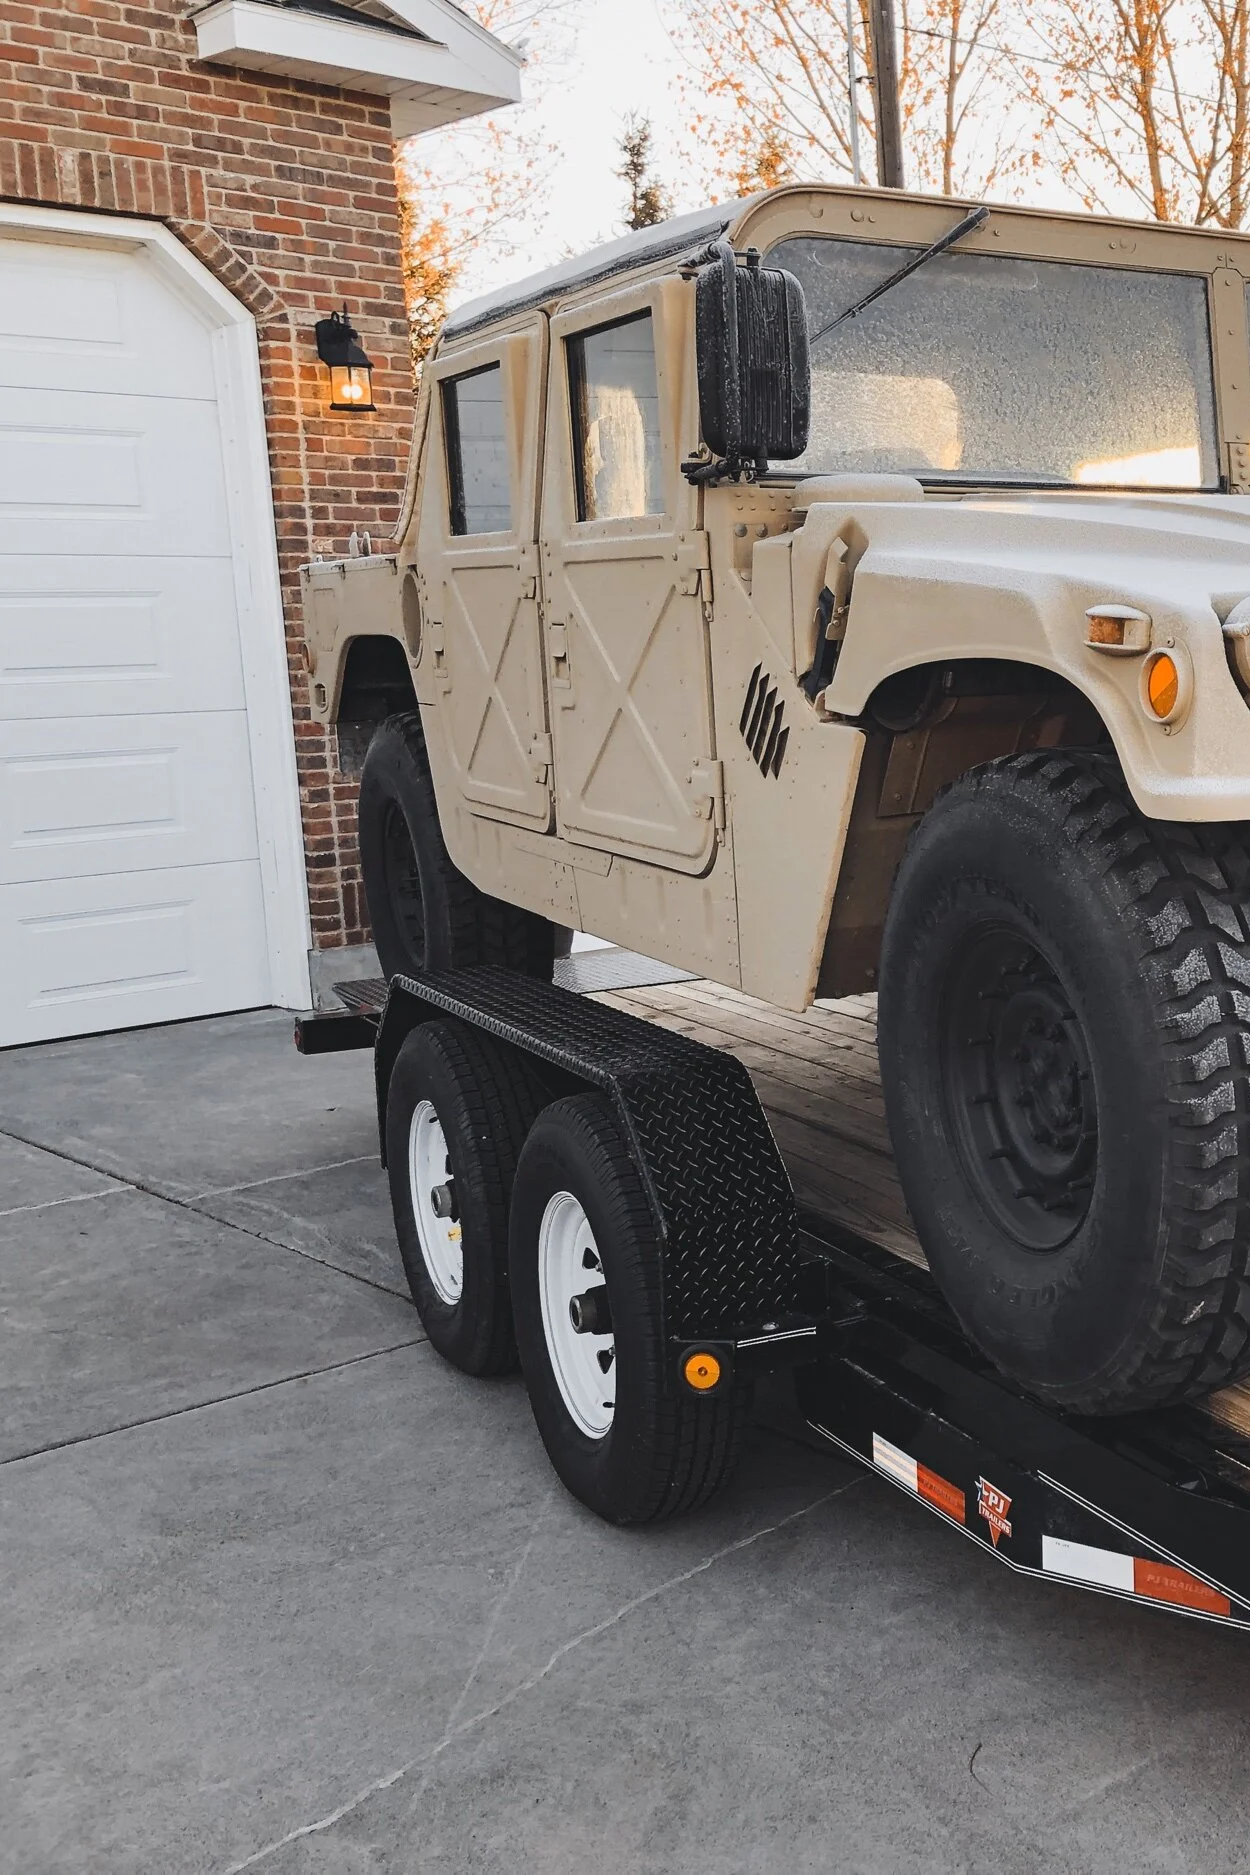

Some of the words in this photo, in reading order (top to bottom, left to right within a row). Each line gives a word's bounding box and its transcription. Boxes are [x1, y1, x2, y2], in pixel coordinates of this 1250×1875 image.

[988, 1490, 1005, 1514] PJ
[981, 1506, 1010, 1534] TRAILERS
[1146, 1574, 1161, 1585] PJ
[1162, 1576, 1215, 1597] TRAILERS
